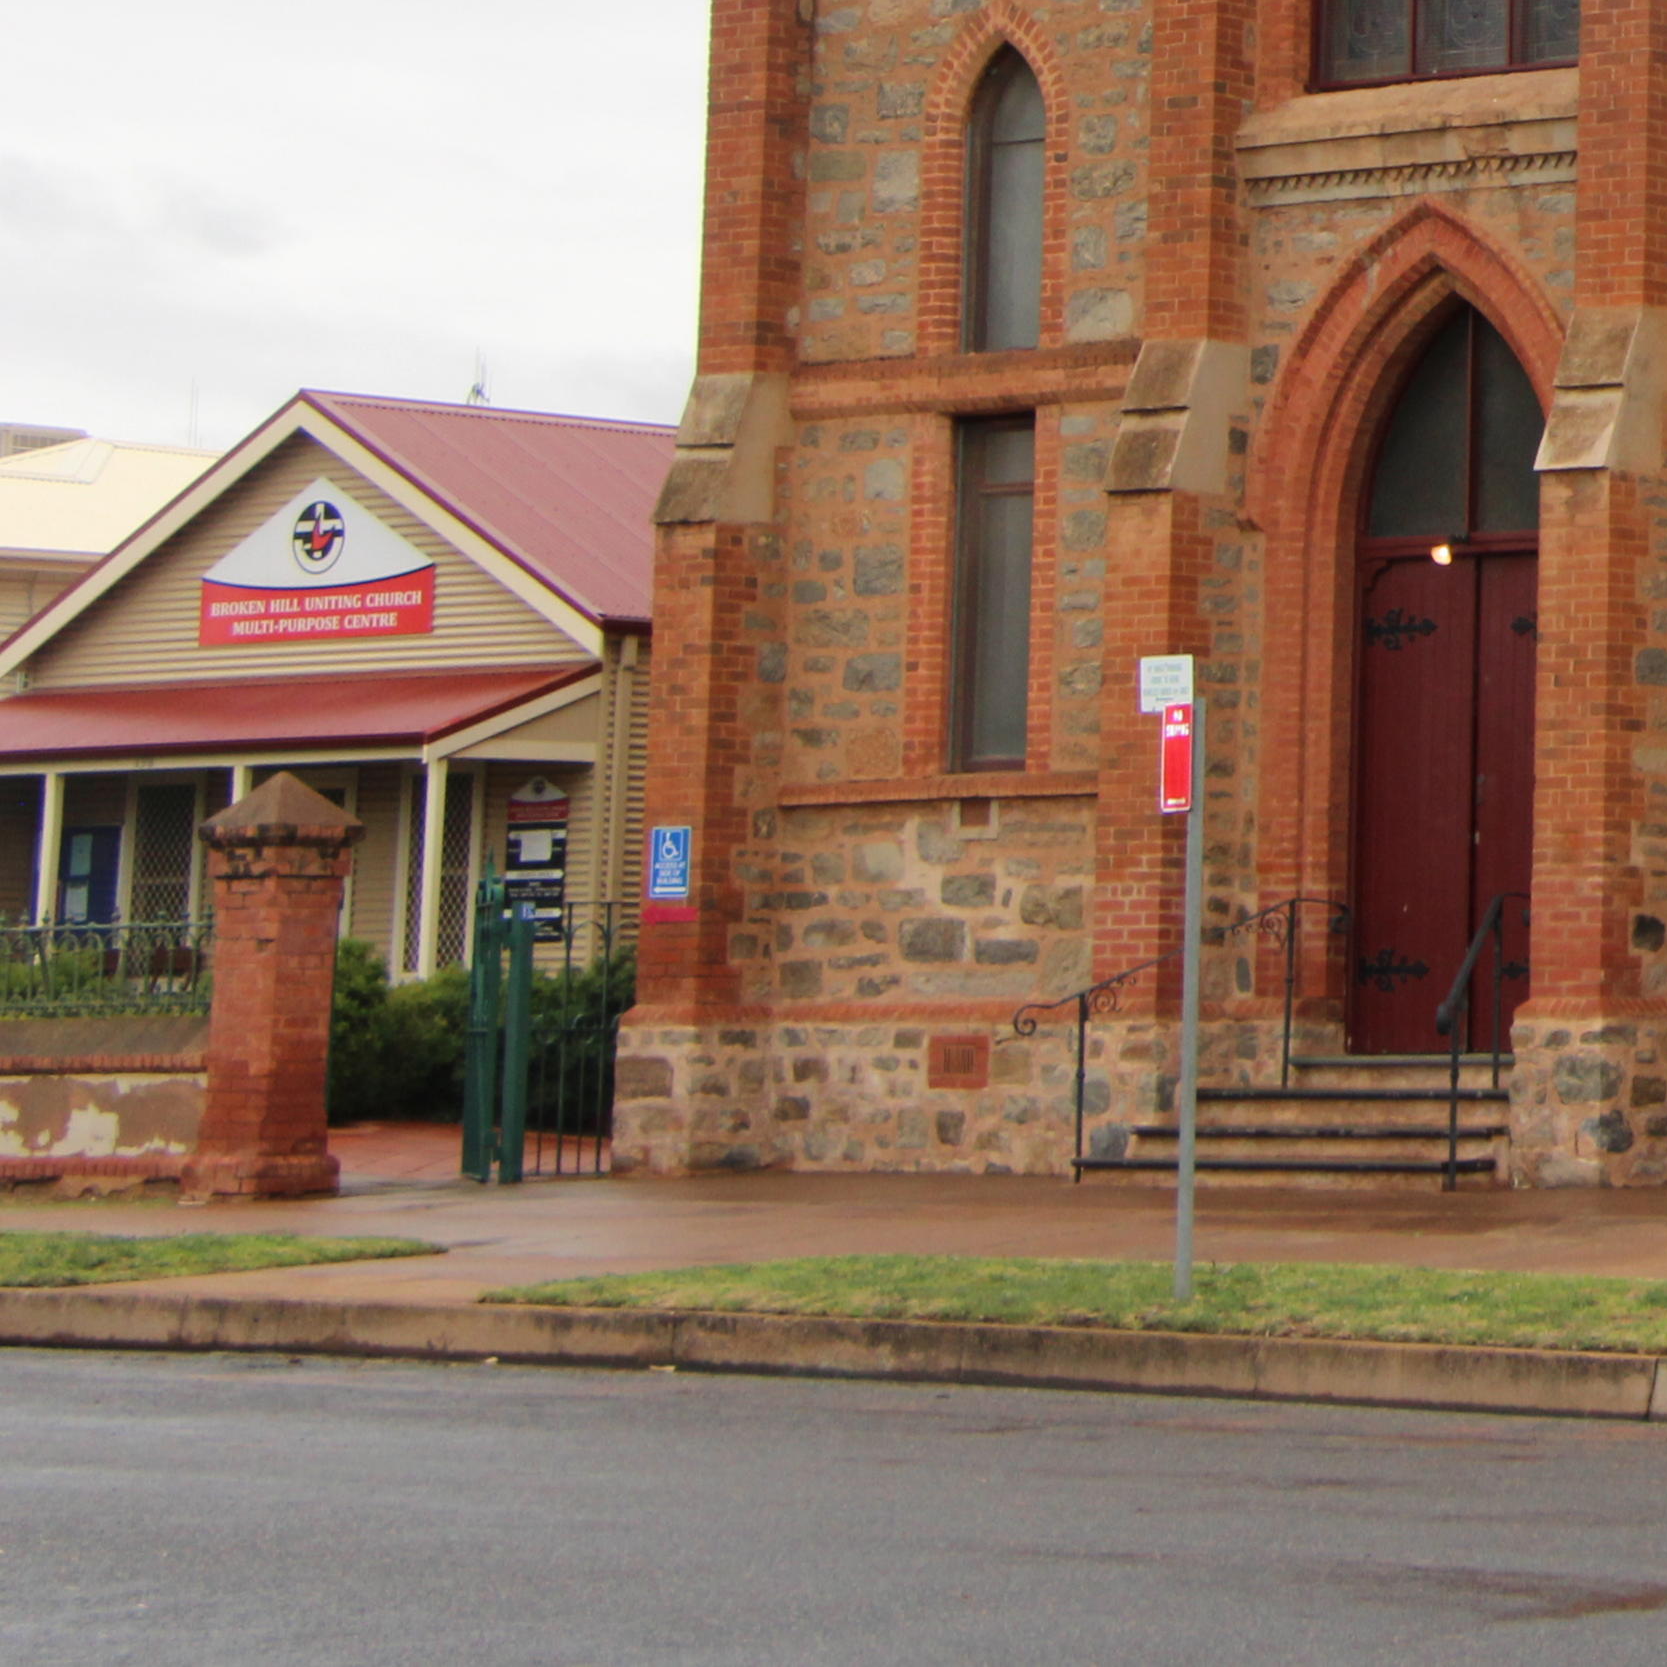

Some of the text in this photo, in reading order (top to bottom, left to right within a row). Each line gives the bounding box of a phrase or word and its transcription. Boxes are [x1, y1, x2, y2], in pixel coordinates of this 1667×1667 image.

[211, 590, 423, 617] BROKEN HILL UNITING CHURCH
[231, 612, 398, 636] MULTI-PURPOSE CENTRE
